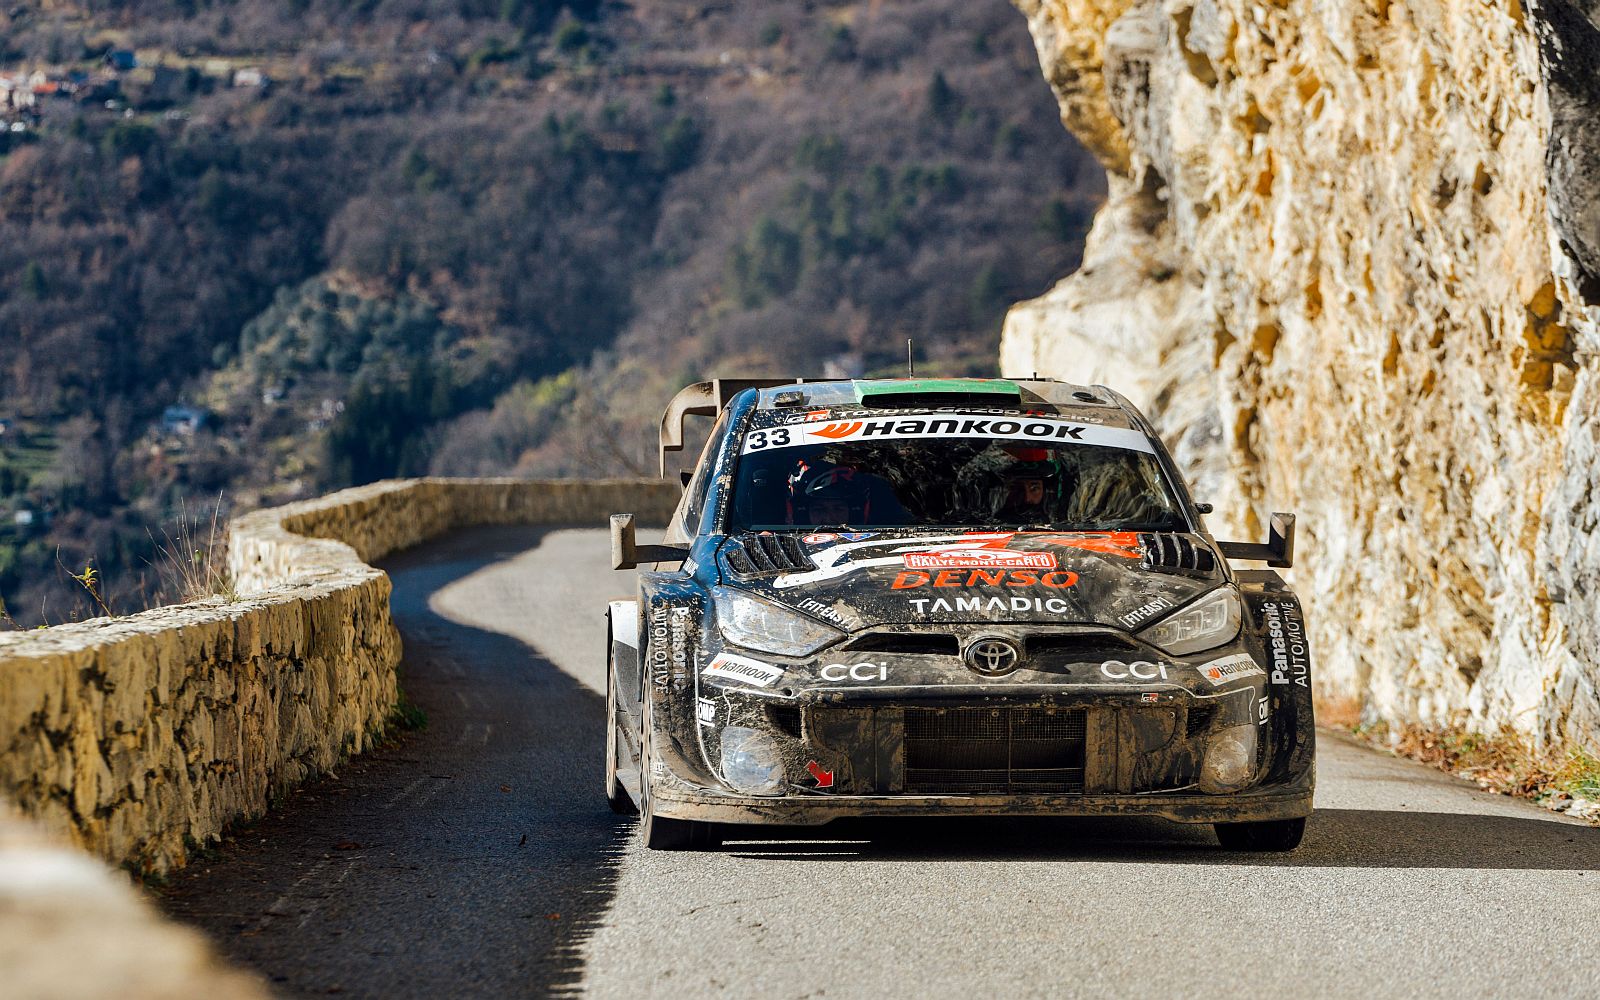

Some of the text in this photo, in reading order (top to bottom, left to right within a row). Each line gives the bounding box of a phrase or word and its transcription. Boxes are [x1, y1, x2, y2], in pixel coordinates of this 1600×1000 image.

[836, 408, 931, 418] TOYOTA
[936, 406, 1020, 417] GAZOO
[749, 428, 791, 450] 33
[910, 557, 955, 567] RALLYE
[958, 557, 1051, 567] MONTE-CARLO
[891, 570, 1079, 590] DENSO
[909, 597, 1067, 614] TAMADIC
[654, 607, 669, 694] AUTOMOTIVE
[1261, 602, 1290, 685] Panasonic
[1280, 602, 1308, 688] AUTOMOTIVE
